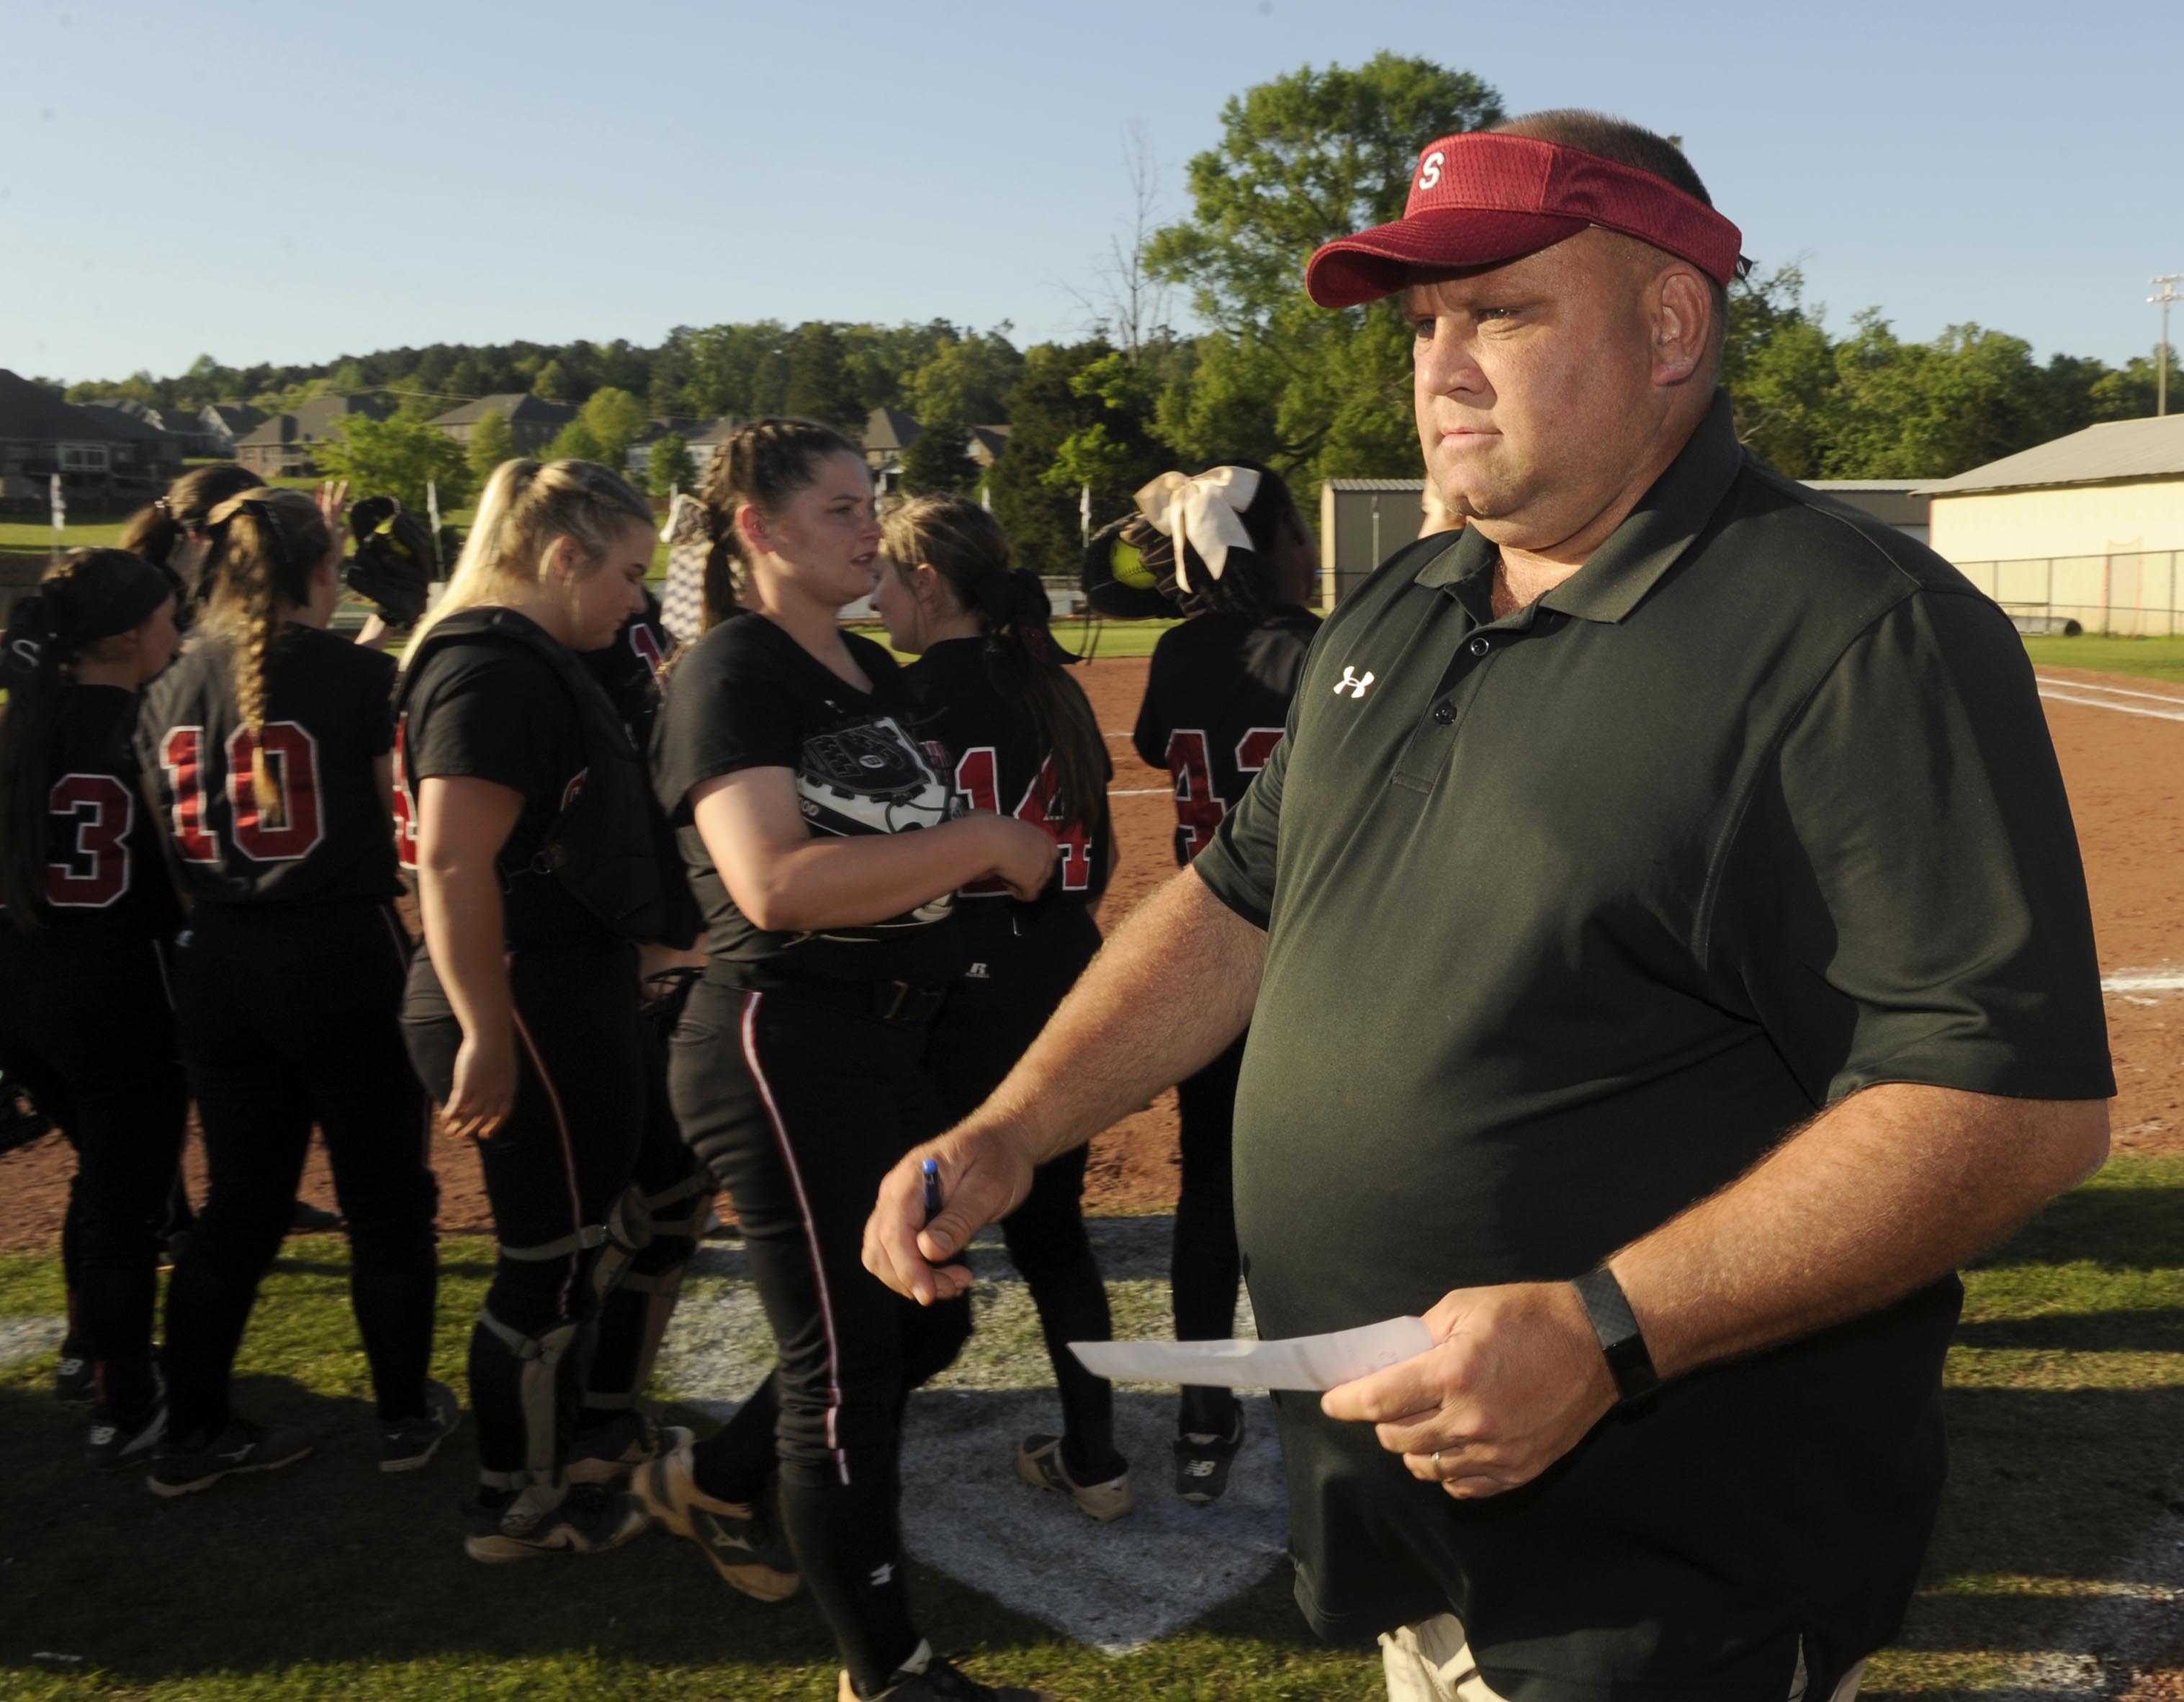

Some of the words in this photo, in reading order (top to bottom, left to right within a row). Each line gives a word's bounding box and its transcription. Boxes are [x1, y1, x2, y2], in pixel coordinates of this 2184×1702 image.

[1419, 151, 1446, 191] S
[158, 720, 325, 863] 10
[46, 773, 133, 908] 3
[1183, 1459, 1217, 1477] NB
